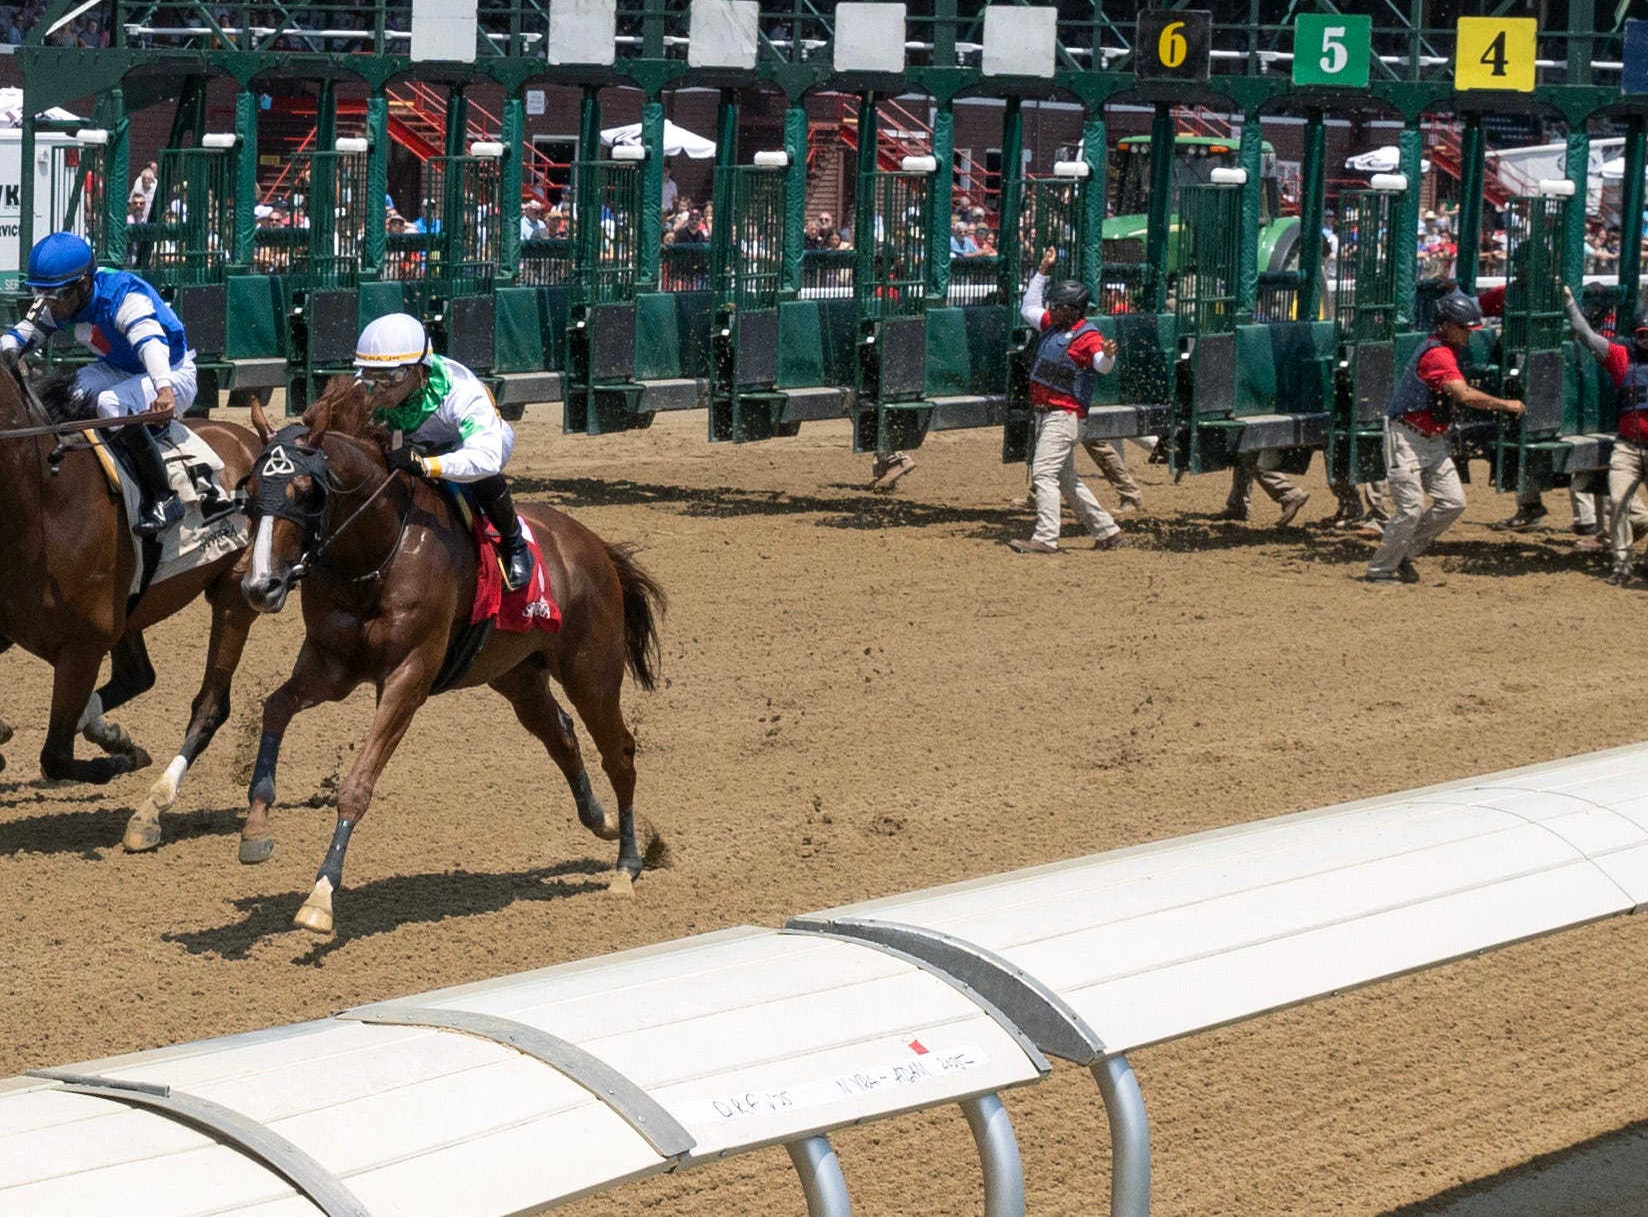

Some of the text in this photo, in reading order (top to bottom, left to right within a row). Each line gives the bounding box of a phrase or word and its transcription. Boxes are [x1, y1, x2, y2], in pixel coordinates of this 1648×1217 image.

[1159, 21, 1188, 68] 6
[1318, 26, 1348, 74] 5
[1479, 30, 1509, 77] 4
